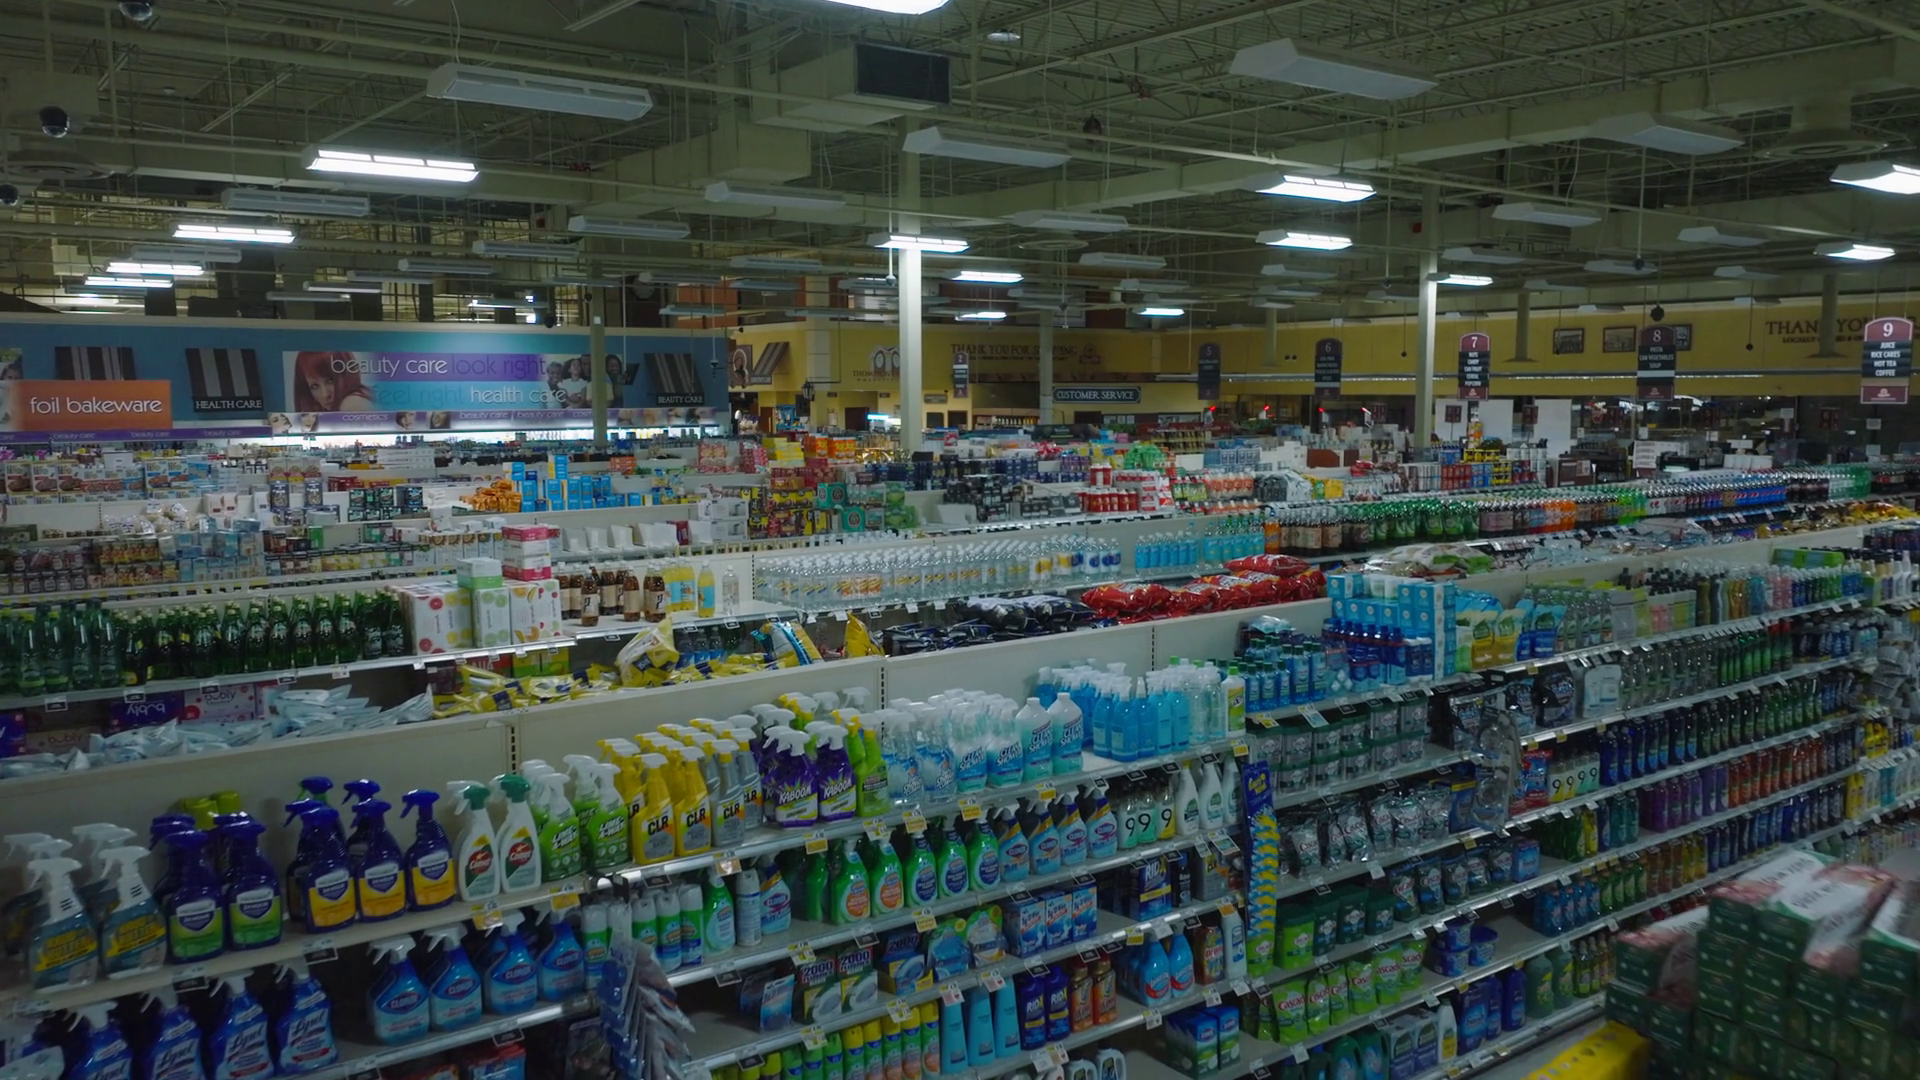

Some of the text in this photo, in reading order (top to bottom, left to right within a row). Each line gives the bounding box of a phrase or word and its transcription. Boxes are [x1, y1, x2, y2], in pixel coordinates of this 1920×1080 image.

[1765, 319, 1818, 335] THAN
[1883, 322, 1893, 337] 9
[1471, 336, 1478, 348] 7
[1653, 329, 1661, 342] 8
[988, 345, 1010, 355] YOU
[1011, 344, 1030, 355] FOR
[1206, 346, 1212, 356] 5
[1325, 342, 1331, 353] 6
[330, 355, 546, 379] beauty care look right
[470, 386, 523, 404] health
[529, 388, 567, 403] care
[658, 395, 703, 404] BEAUTY CARE
[1056, 391, 1134, 400] CUSTOMER SERVICE
[30, 396, 162, 414] foil bakeware
[195, 400, 262, 409] HEALTH CARE
[342, 413, 388, 422] cosmetics
[459, 411, 487, 420] beauty
[517, 411, 547, 420] beauty
[126, 702, 165, 715] bubly
[1578, 770, 1585, 785] 9
[1589, 767, 1597, 782] 9
[823, 779, 851, 799] KABOOM
[1553, 779, 1561, 794] 9
[1567, 776, 1575, 790] 9
[779, 786, 811, 805] KABOOM
[686, 807, 705, 828] CLR
[723, 802, 740, 819] CLR
[1161, 808, 1172, 828] 9
[648, 815, 669, 836] CLR
[1096, 823, 1115, 834] CLOROX
[1125, 818, 1136, 837] 9
[1139, 813, 1150, 832] 9
[1008, 845, 1026, 856] CLOROX
[1040, 838, 1057, 850] CLOROX
[889, 935, 918, 950] 2000
[556, 952, 579, 966] CLOROX
[839, 951, 870, 967] 2000
[505, 965, 533, 979] CLOROX
[802, 961, 834, 978] 2000
[448, 980, 474, 994] CLOROX
[390, 993, 419, 1009] CLOROX
[292, 1010, 325, 1035] Lysol
[230, 1026, 262, 1050] Lysol
[160, 1044, 192, 1066] Lysol
